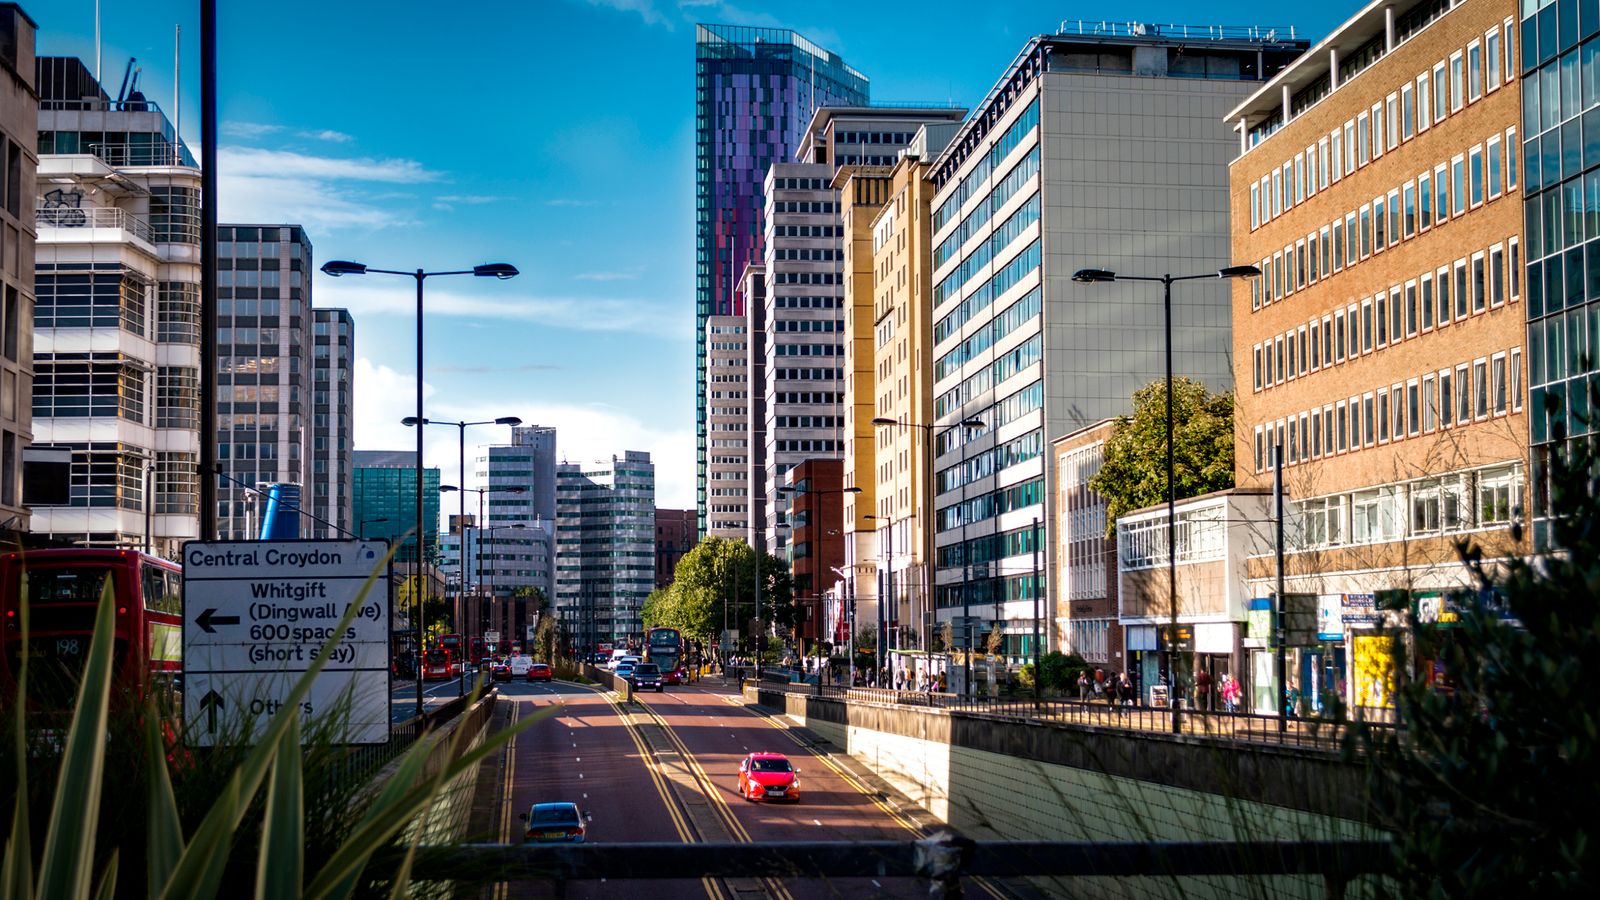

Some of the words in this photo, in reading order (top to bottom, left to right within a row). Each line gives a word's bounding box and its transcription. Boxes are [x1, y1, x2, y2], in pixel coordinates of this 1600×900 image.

[189, 550, 259, 566] Central
[265, 549, 342, 568] Croydon
[251, 582, 326, 601] Whitgift
[249, 602, 337, 622] (Dingwall
[250, 624, 290, 641] 600
[56, 639, 79, 655] 198
[249, 645, 304, 665] (short
[250, 699, 313, 715] Oths
